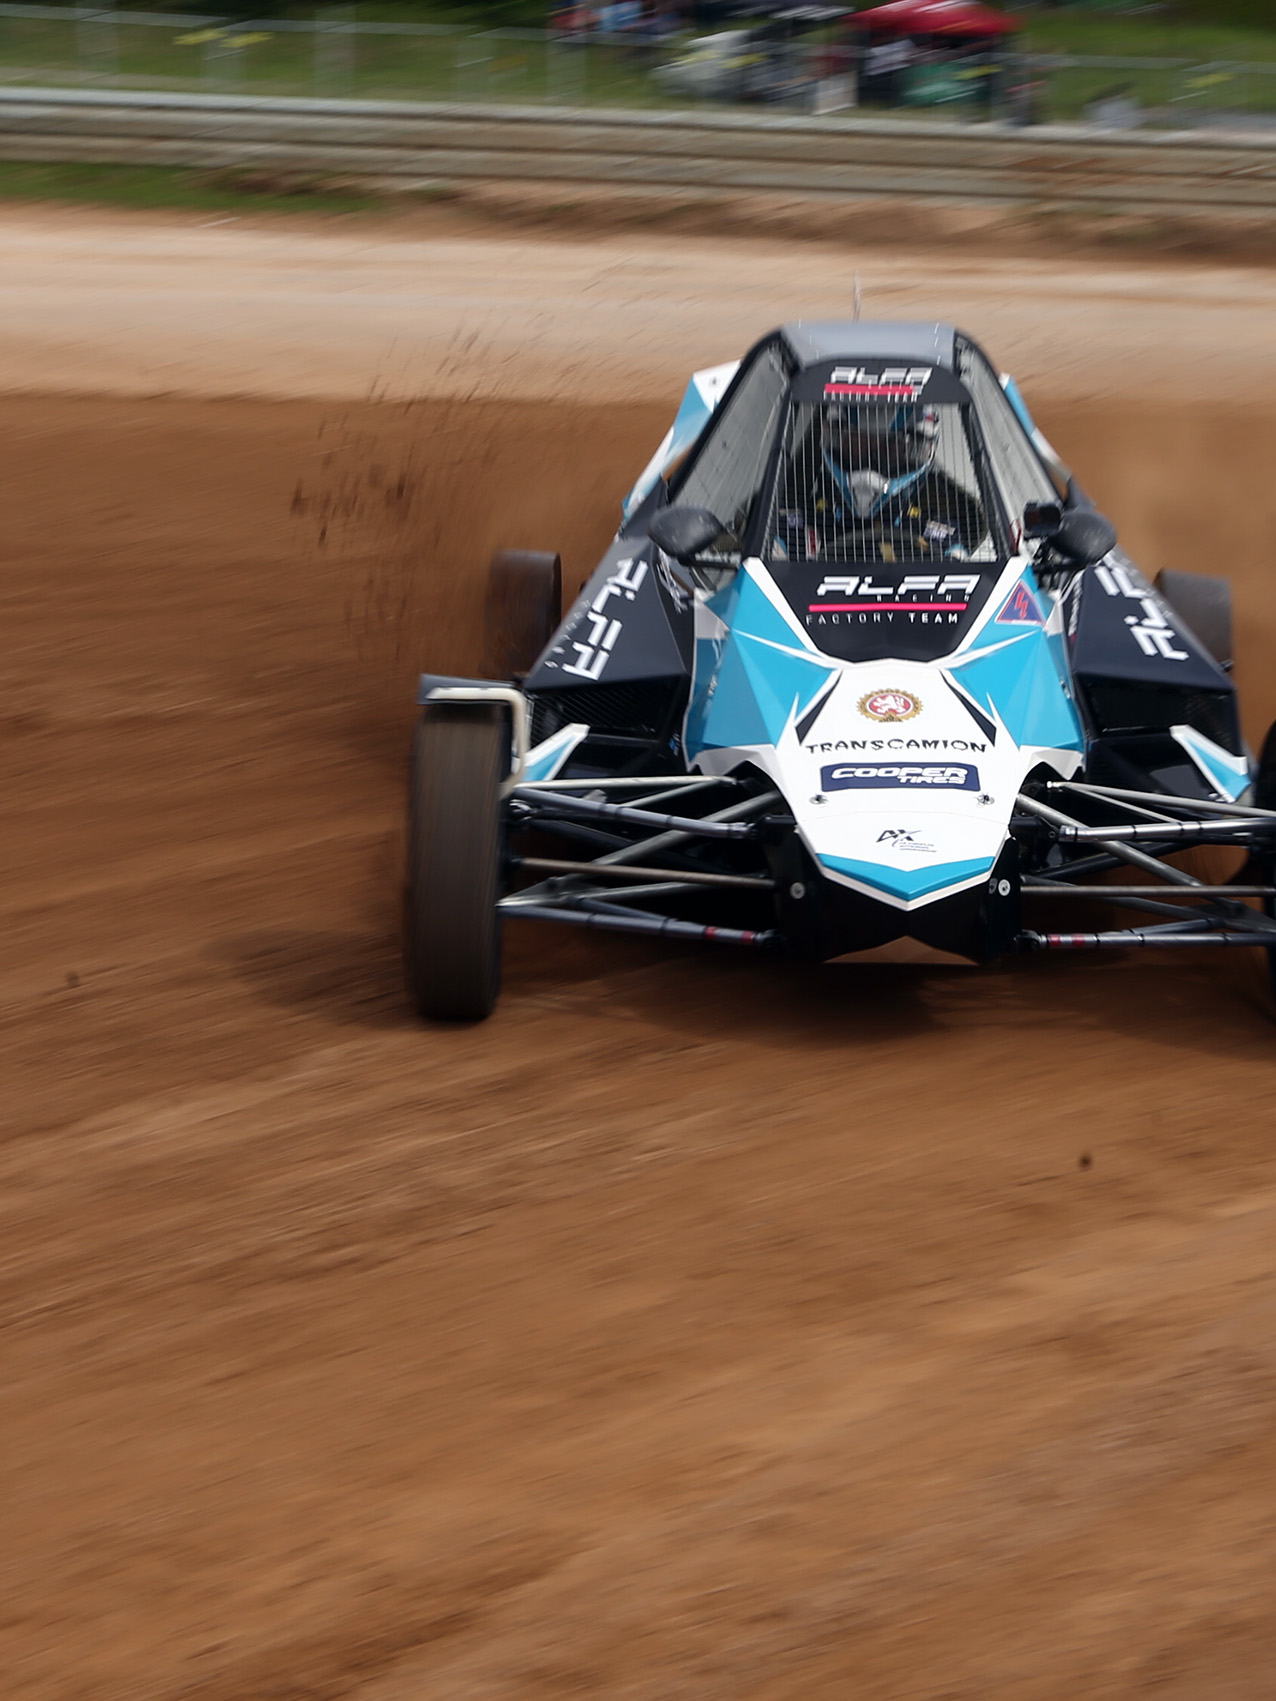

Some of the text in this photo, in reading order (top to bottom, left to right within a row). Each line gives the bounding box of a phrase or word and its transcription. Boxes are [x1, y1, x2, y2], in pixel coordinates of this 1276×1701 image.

[831, 366, 932, 385] ALFA
[817, 574, 981, 596] ALFA
[805, 612, 958, 626] FACTORY TEAM
[805, 738, 987, 753] TRANSCAMION
[831, 767, 968, 779] COOPER
[897, 776, 966, 785] TIRES
